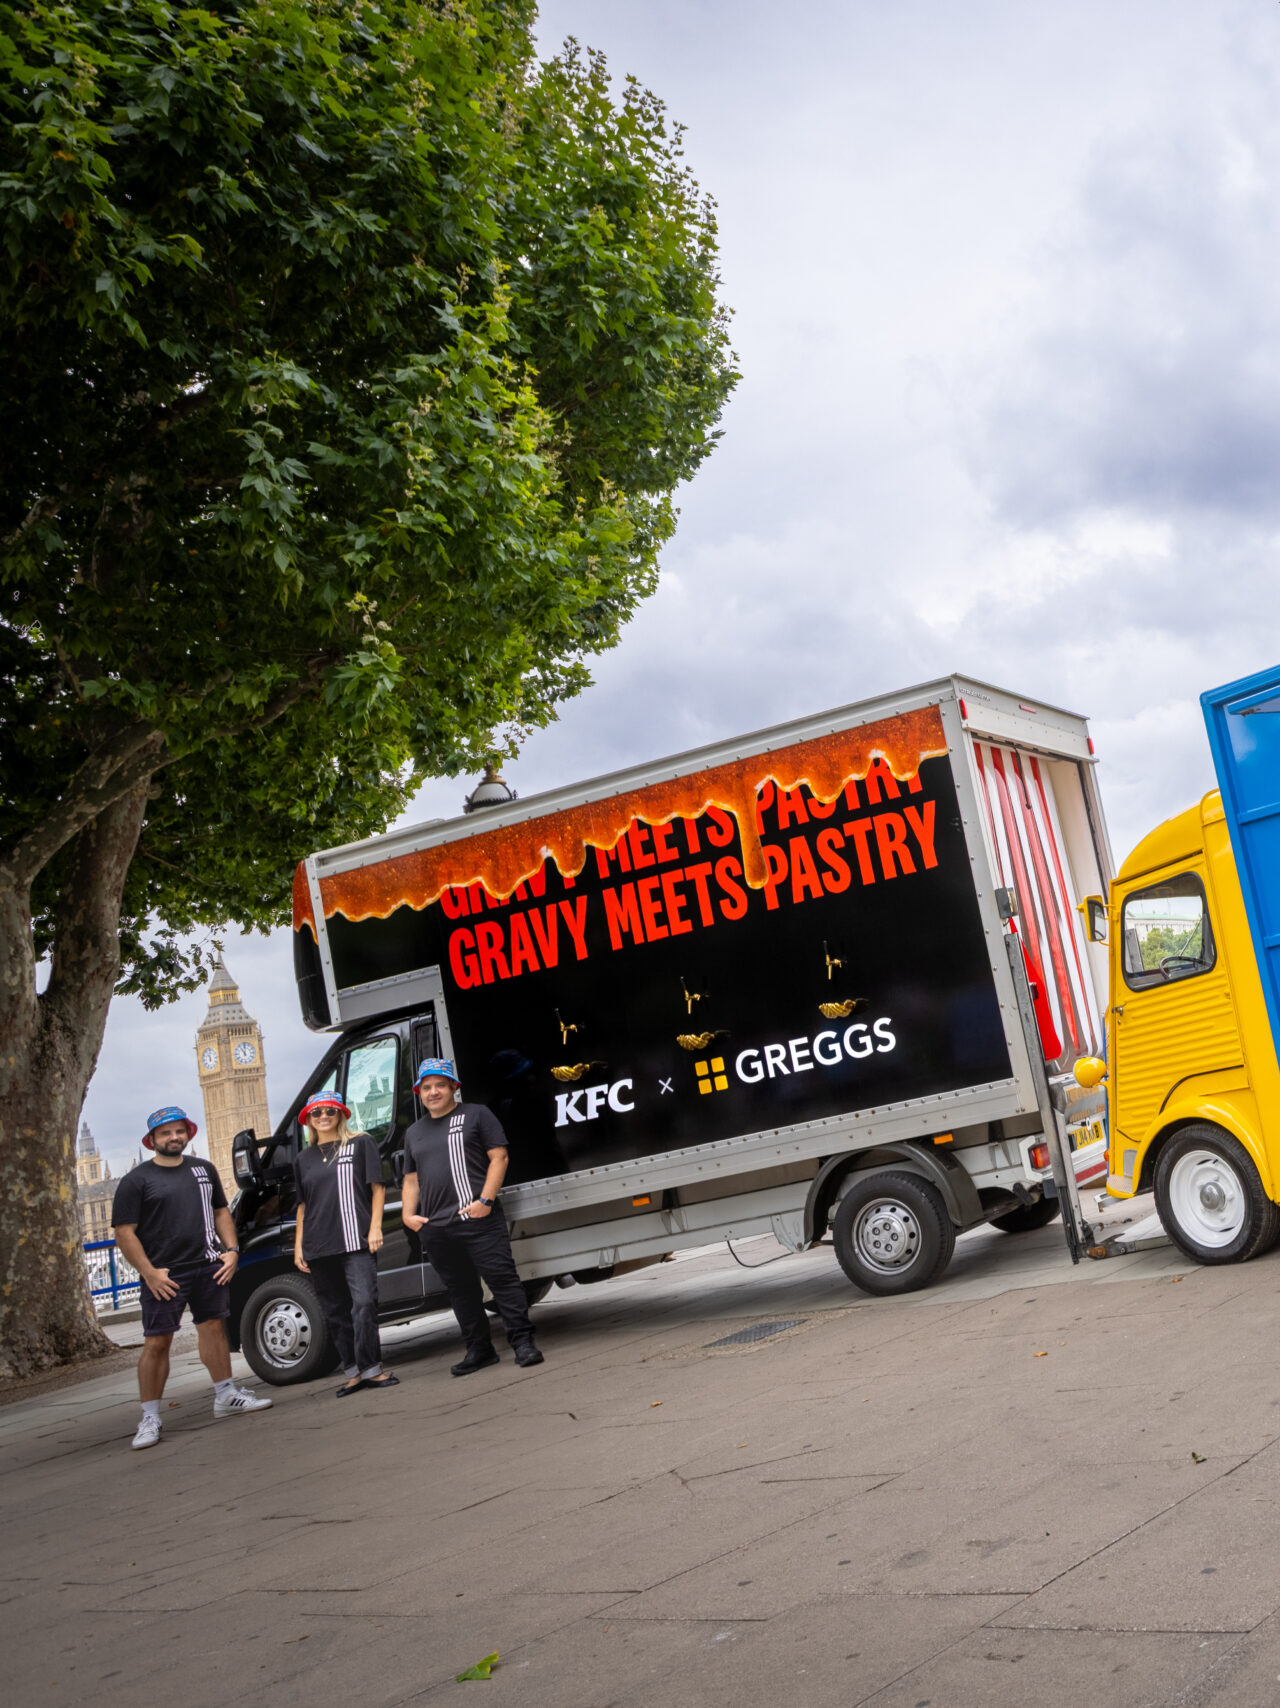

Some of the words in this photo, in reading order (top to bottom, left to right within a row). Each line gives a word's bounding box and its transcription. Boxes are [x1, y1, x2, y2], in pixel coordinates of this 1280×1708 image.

[756, 757, 923, 836] PAR
[448, 894, 589, 990] GRAVY
[602, 855, 748, 951] MEETS
[761, 800, 939, 911] PASTRY
[553, 1078, 635, 1128] KFC
[735, 1017, 897, 1084] GREGGS
[449, 1125, 463, 1133] KFC
